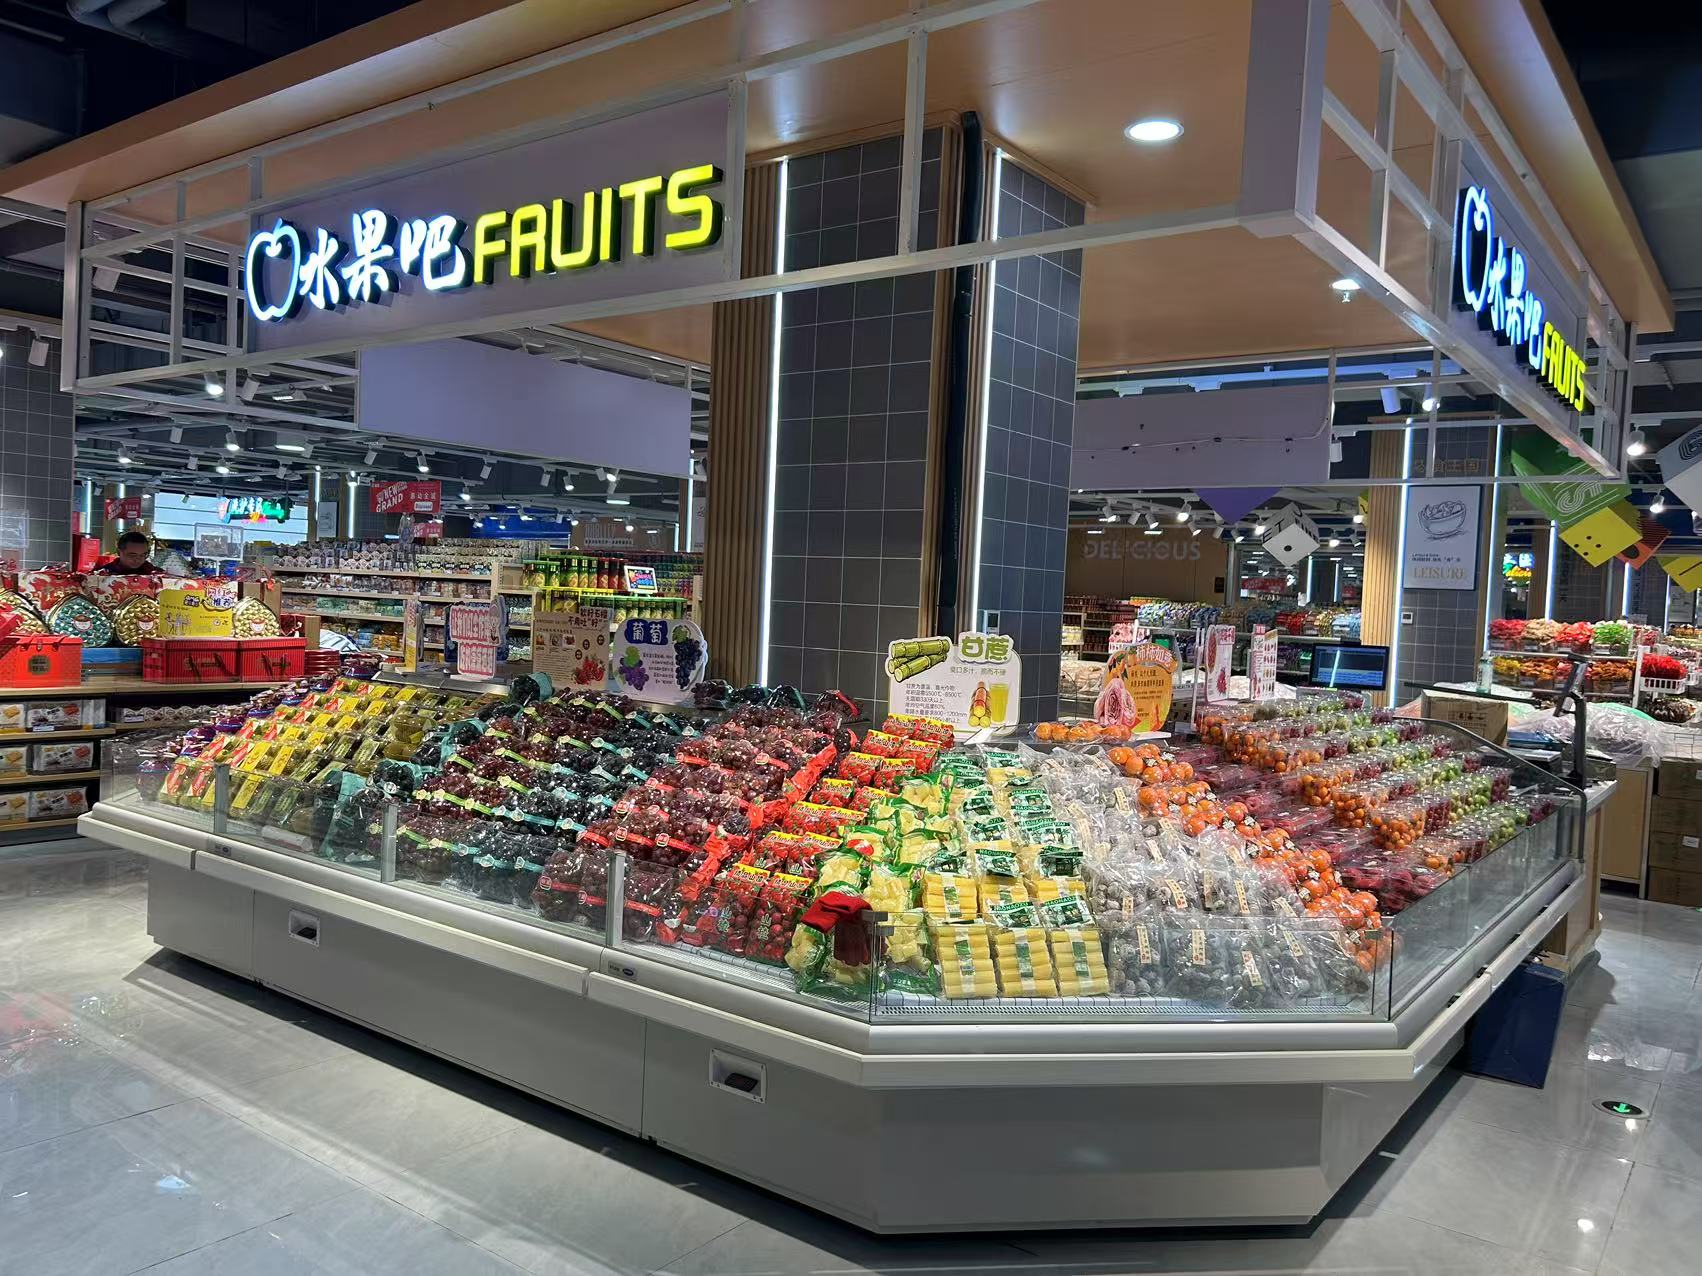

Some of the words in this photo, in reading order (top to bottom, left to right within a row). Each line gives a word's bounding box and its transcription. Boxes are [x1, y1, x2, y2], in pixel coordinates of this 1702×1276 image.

[300, 208, 466, 310] 水果吧
[474, 164, 715, 284] FRUITS
[1488, 236, 1543, 370] 水果吧
[1541, 321, 1587, 412] FRUITS
[1084, 539, 1201, 560] DELICIOUS
[1413, 566, 1467, 580] LEISURE
[632, 621, 663, 644] 葡萄
[961, 635, 1010, 661] 甘蔗
